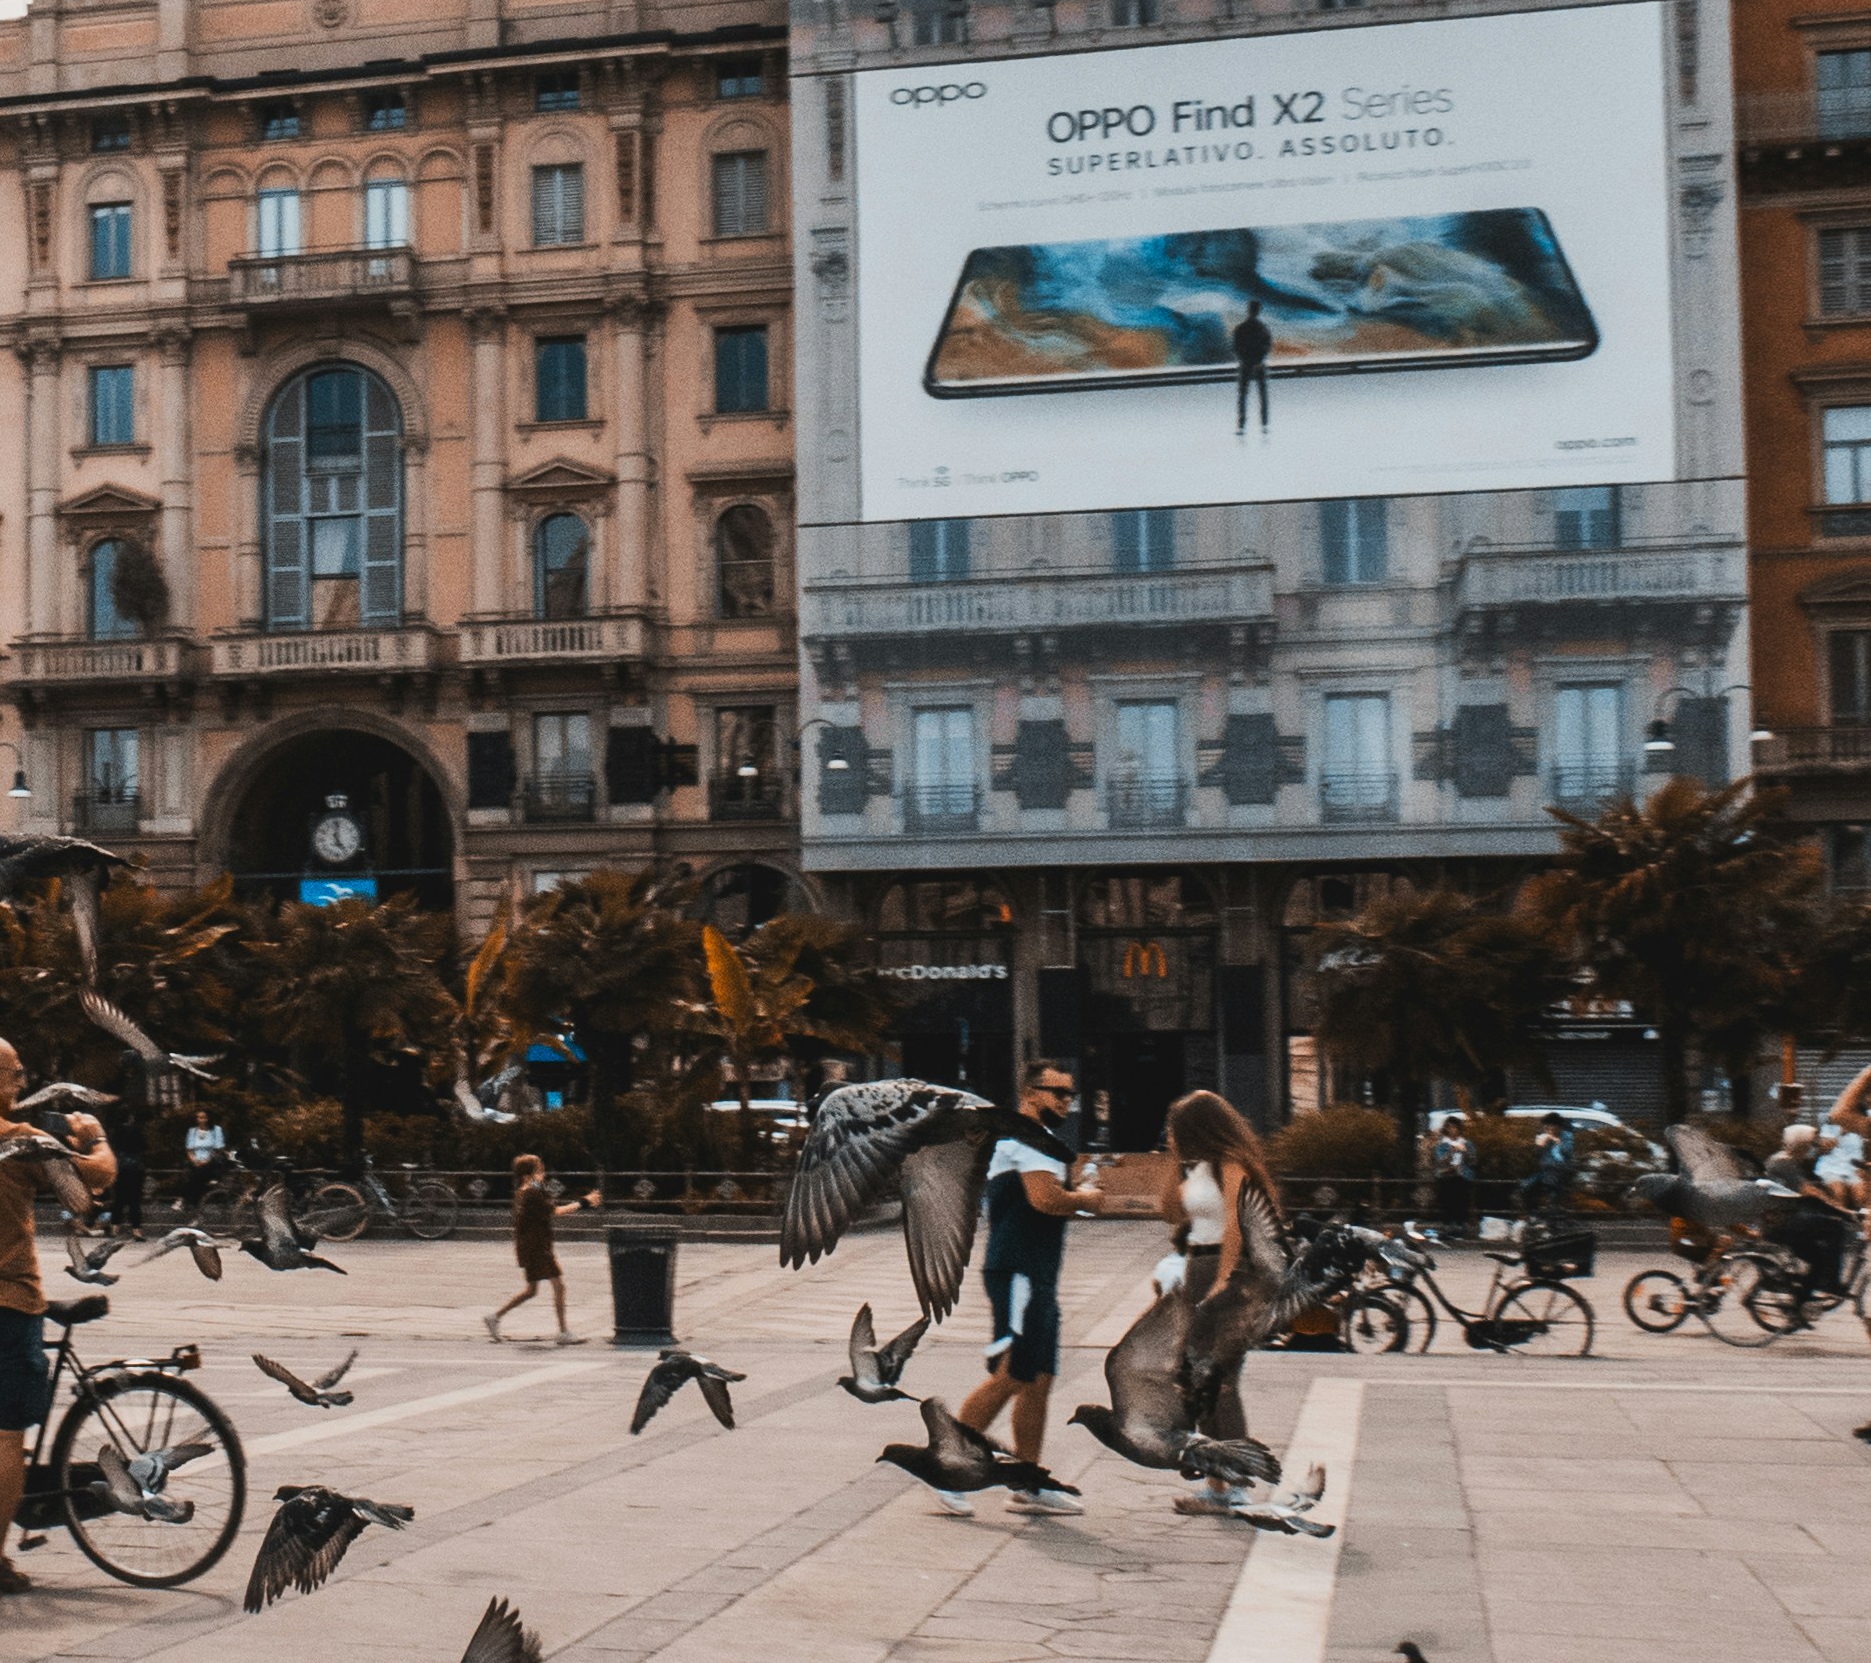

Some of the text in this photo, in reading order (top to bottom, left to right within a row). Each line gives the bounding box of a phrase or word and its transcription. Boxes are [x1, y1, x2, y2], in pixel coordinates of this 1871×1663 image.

[889, 81, 988, 109] oppo
[1046, 84, 1454, 143] OPPO Find X2 Series
[1046, 126, 1456, 177] SUPERLATIVO. ASSOLUTO.
